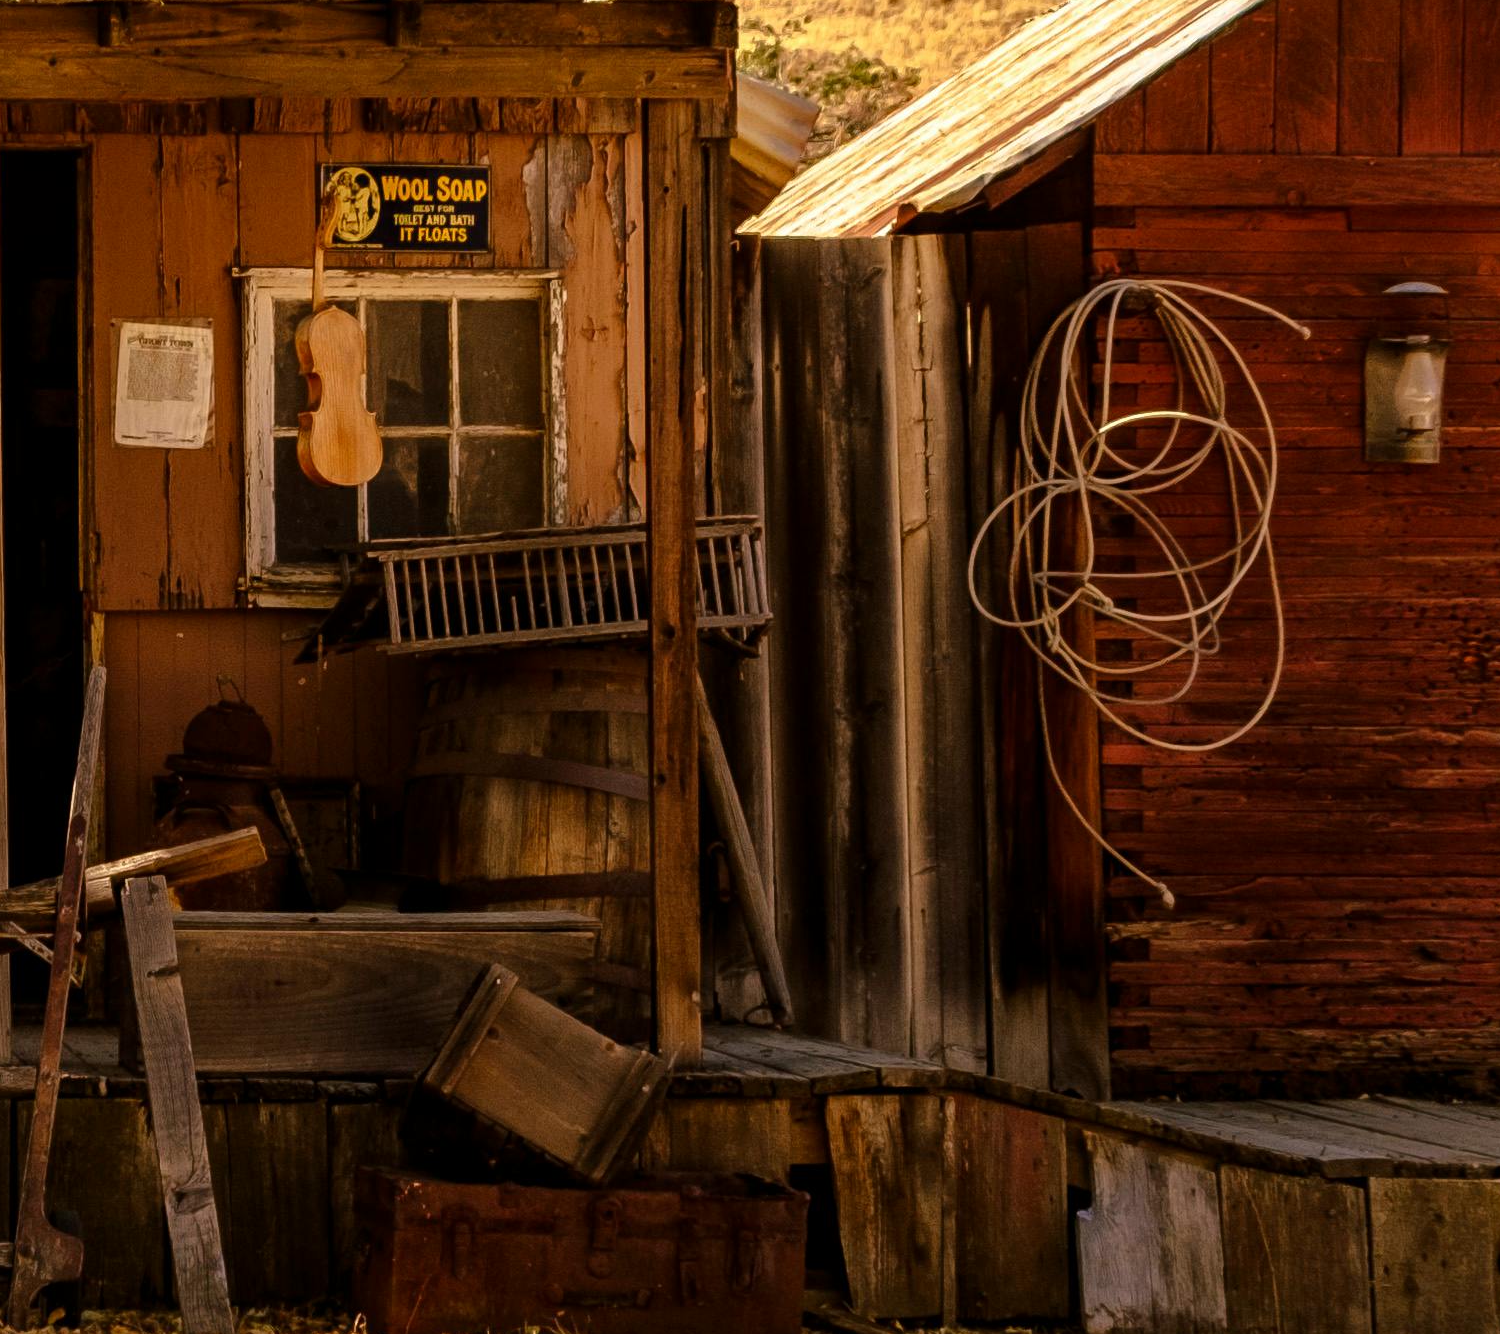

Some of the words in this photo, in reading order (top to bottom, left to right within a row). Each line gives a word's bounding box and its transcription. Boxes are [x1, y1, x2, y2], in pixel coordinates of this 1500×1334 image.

[381, 175, 433, 202] WOOL
[437, 175, 487, 202] SOAP
[393, 214, 424, 226] TOILET
[426, 214, 447, 226] AND
[449, 214, 475, 226] BATH
[400, 227, 414, 243] IT
[417, 227, 468, 243] FLOATS
